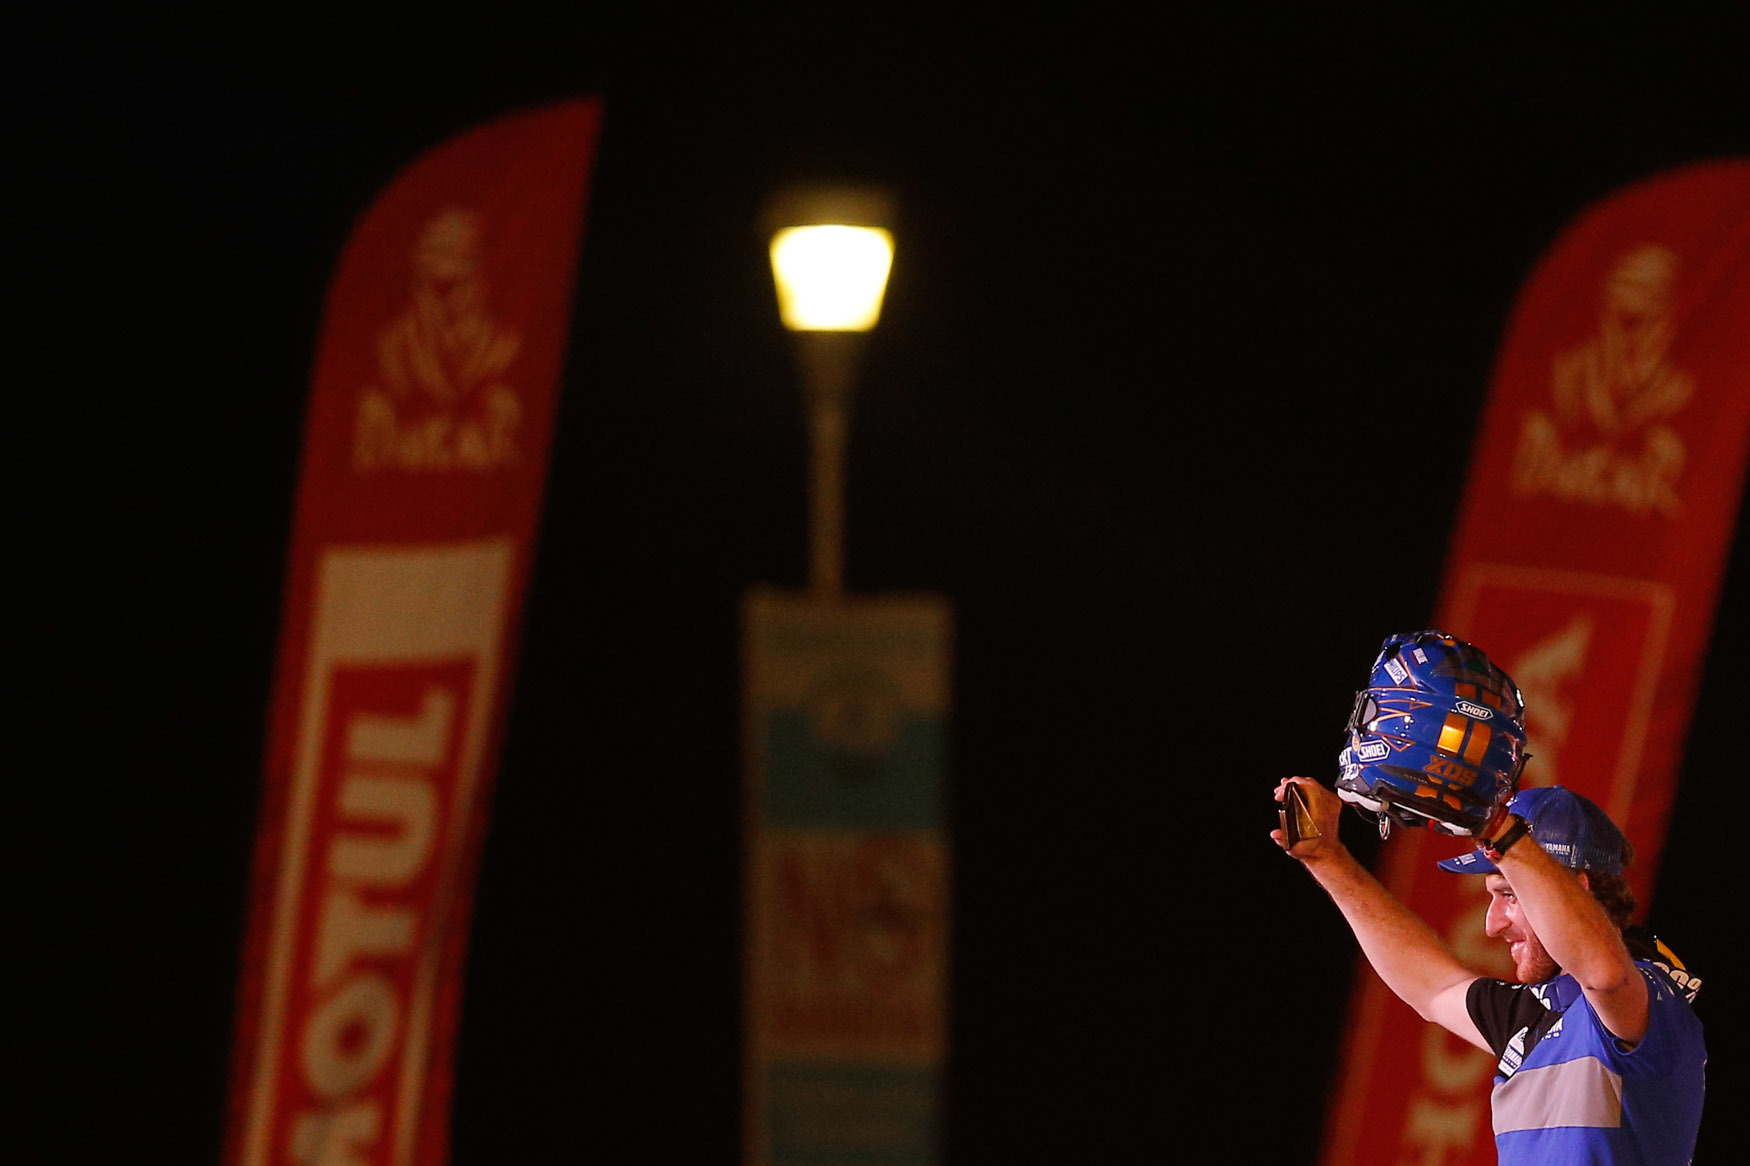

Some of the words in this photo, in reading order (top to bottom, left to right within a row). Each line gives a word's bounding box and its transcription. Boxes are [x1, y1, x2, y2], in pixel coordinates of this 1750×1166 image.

[1460, 703, 1490, 719] SHOEI
[1360, 743, 1385, 760] SHOEI
[1423, 755, 1478, 786] XDS
